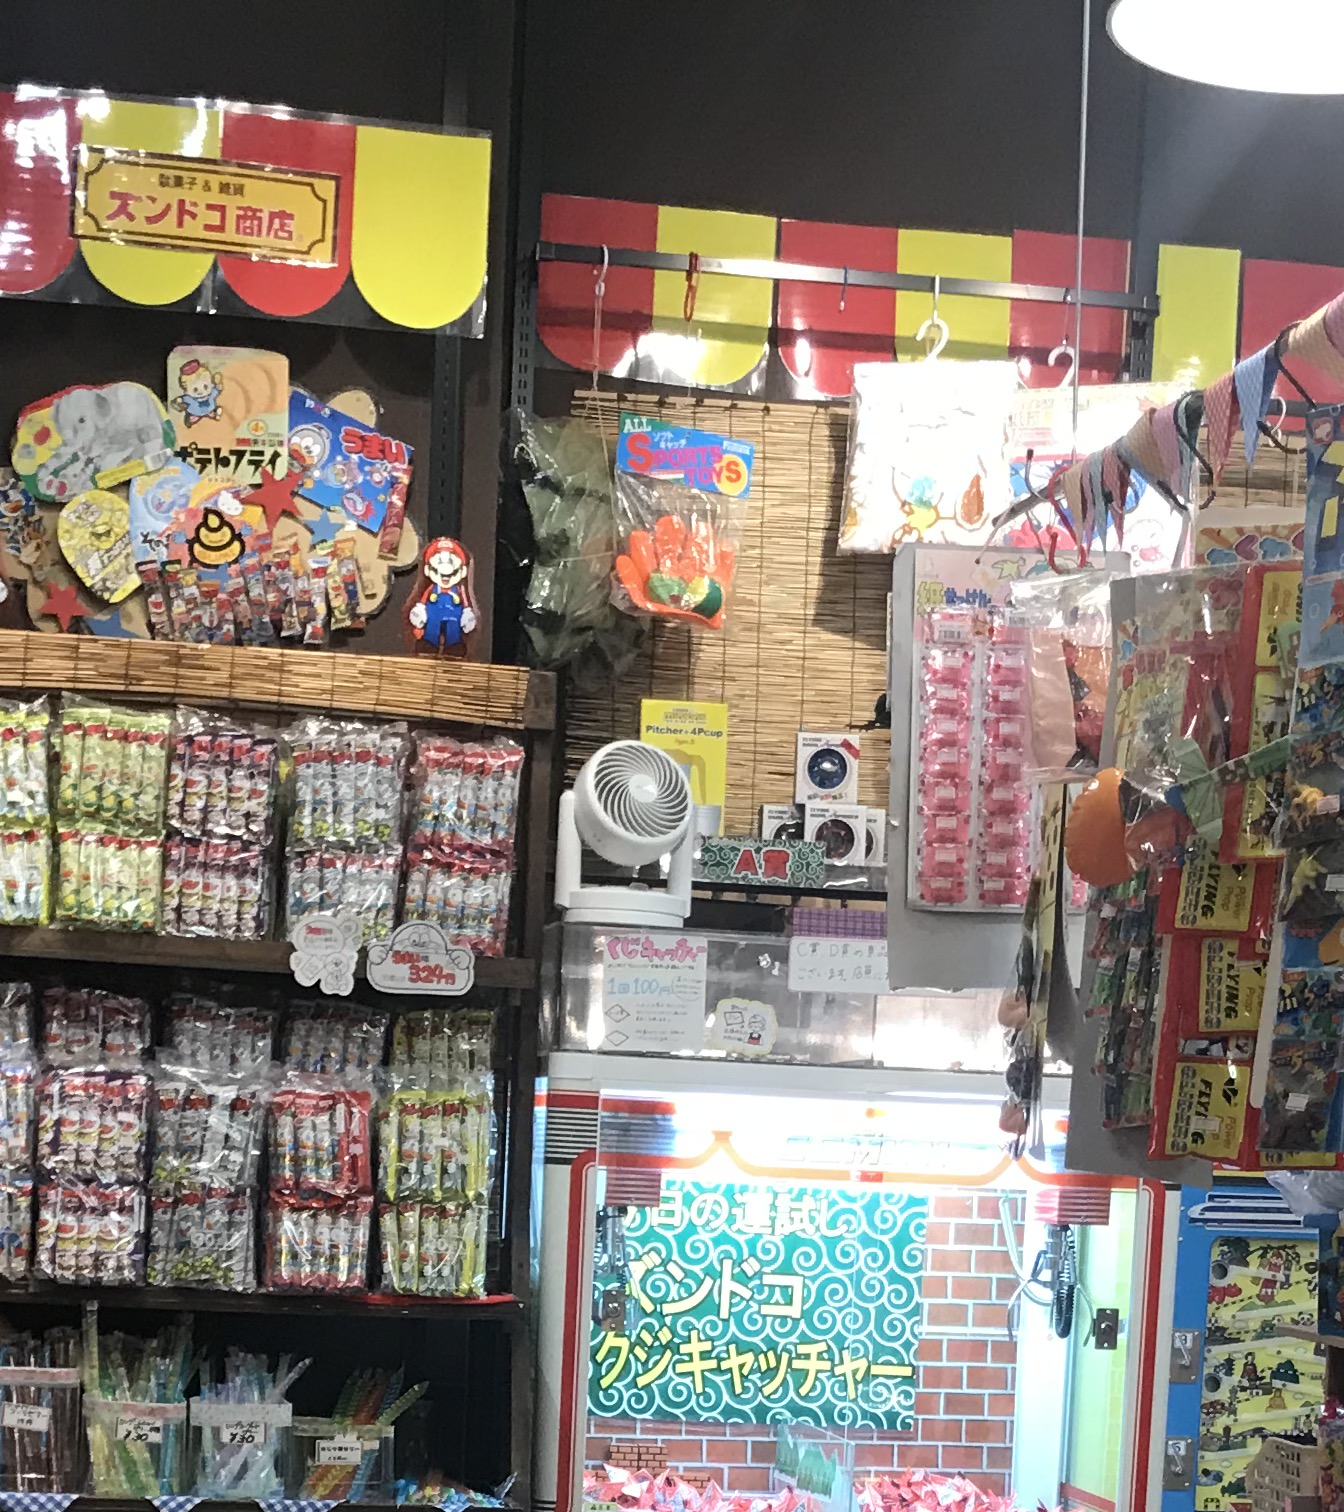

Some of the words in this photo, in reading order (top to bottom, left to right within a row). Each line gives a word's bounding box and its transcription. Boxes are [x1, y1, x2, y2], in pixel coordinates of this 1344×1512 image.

[106, 189, 295, 242] ズンドコ商店
[623, 417, 652, 434] ALL
[626, 431, 724, 472] SPORTS
[683, 459, 743, 488] TOYS
[1189, 1076, 1214, 1148] FLYIG
[622, 1189, 849, 1238] 日の運試し
[595, 1325, 914, 1400] クジキャッチャー
